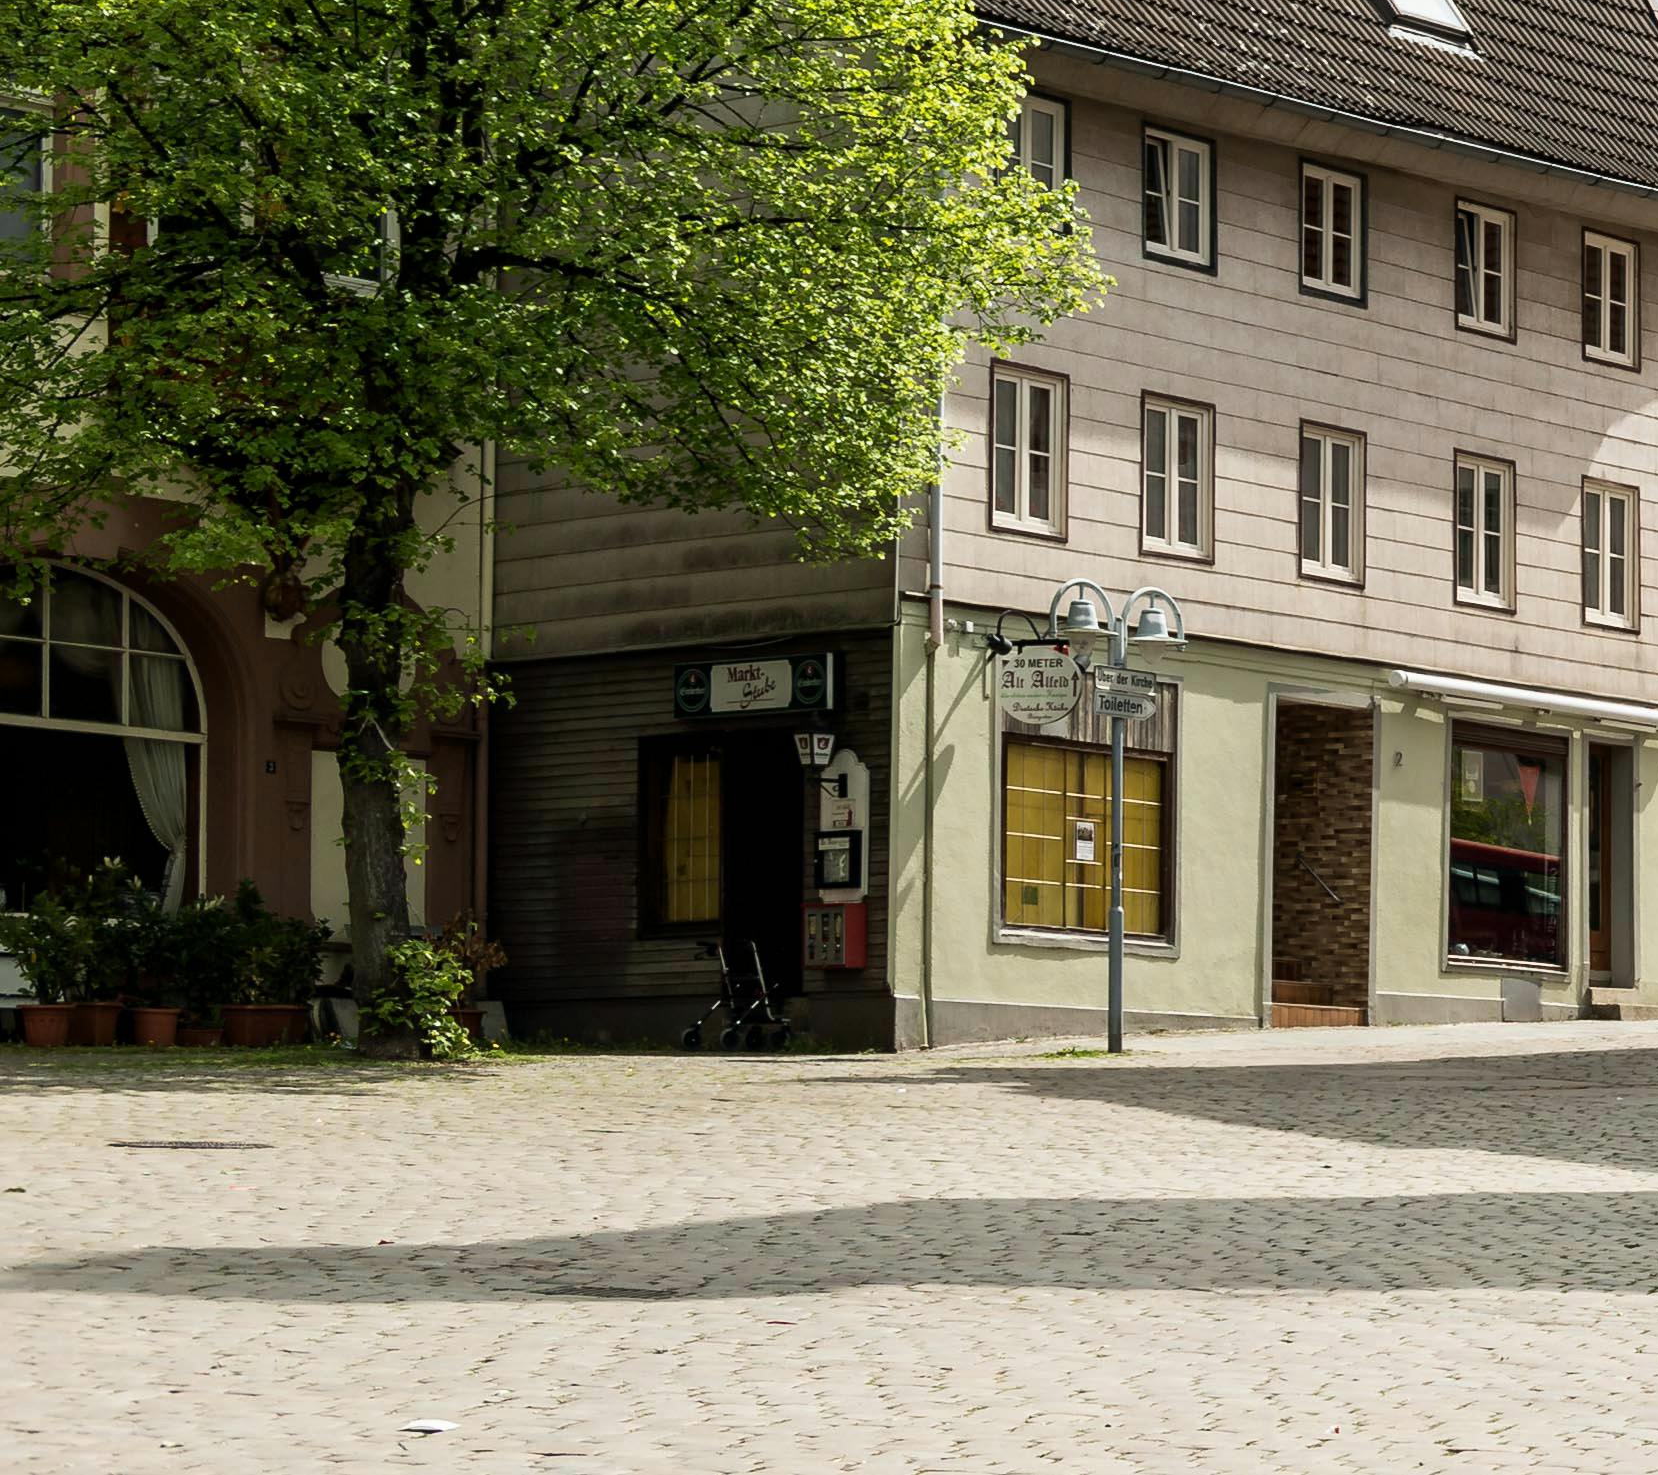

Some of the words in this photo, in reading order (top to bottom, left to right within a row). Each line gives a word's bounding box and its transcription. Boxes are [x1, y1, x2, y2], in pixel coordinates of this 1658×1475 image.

[1013, 659, 1026, 669] 30
[1027, 658, 1064, 668] METER
[726, 664, 765, 683] Markt-
[1001, 670, 1025, 690] Alt
[1030, 669, 1070, 690] Alfeld
[1116, 673, 1129, 685] der
[1131, 674, 1153, 688] Kirche
[740, 676, 776, 709] Stube
[1098, 695, 1143, 714] Toiletten
